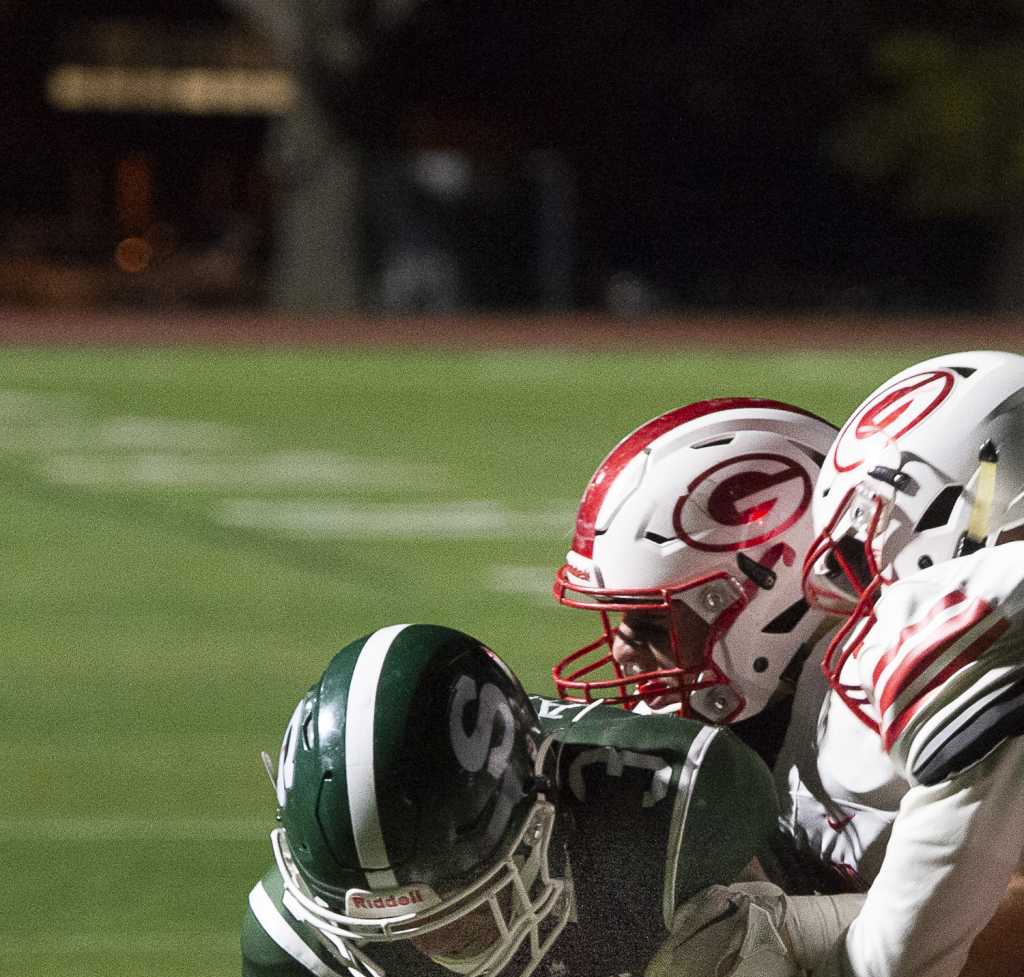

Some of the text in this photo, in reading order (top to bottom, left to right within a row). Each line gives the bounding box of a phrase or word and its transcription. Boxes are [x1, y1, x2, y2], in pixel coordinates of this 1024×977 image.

[672, 452, 813, 552] G
[450, 674, 515, 779] S
[352, 889, 423, 909] Riddell
